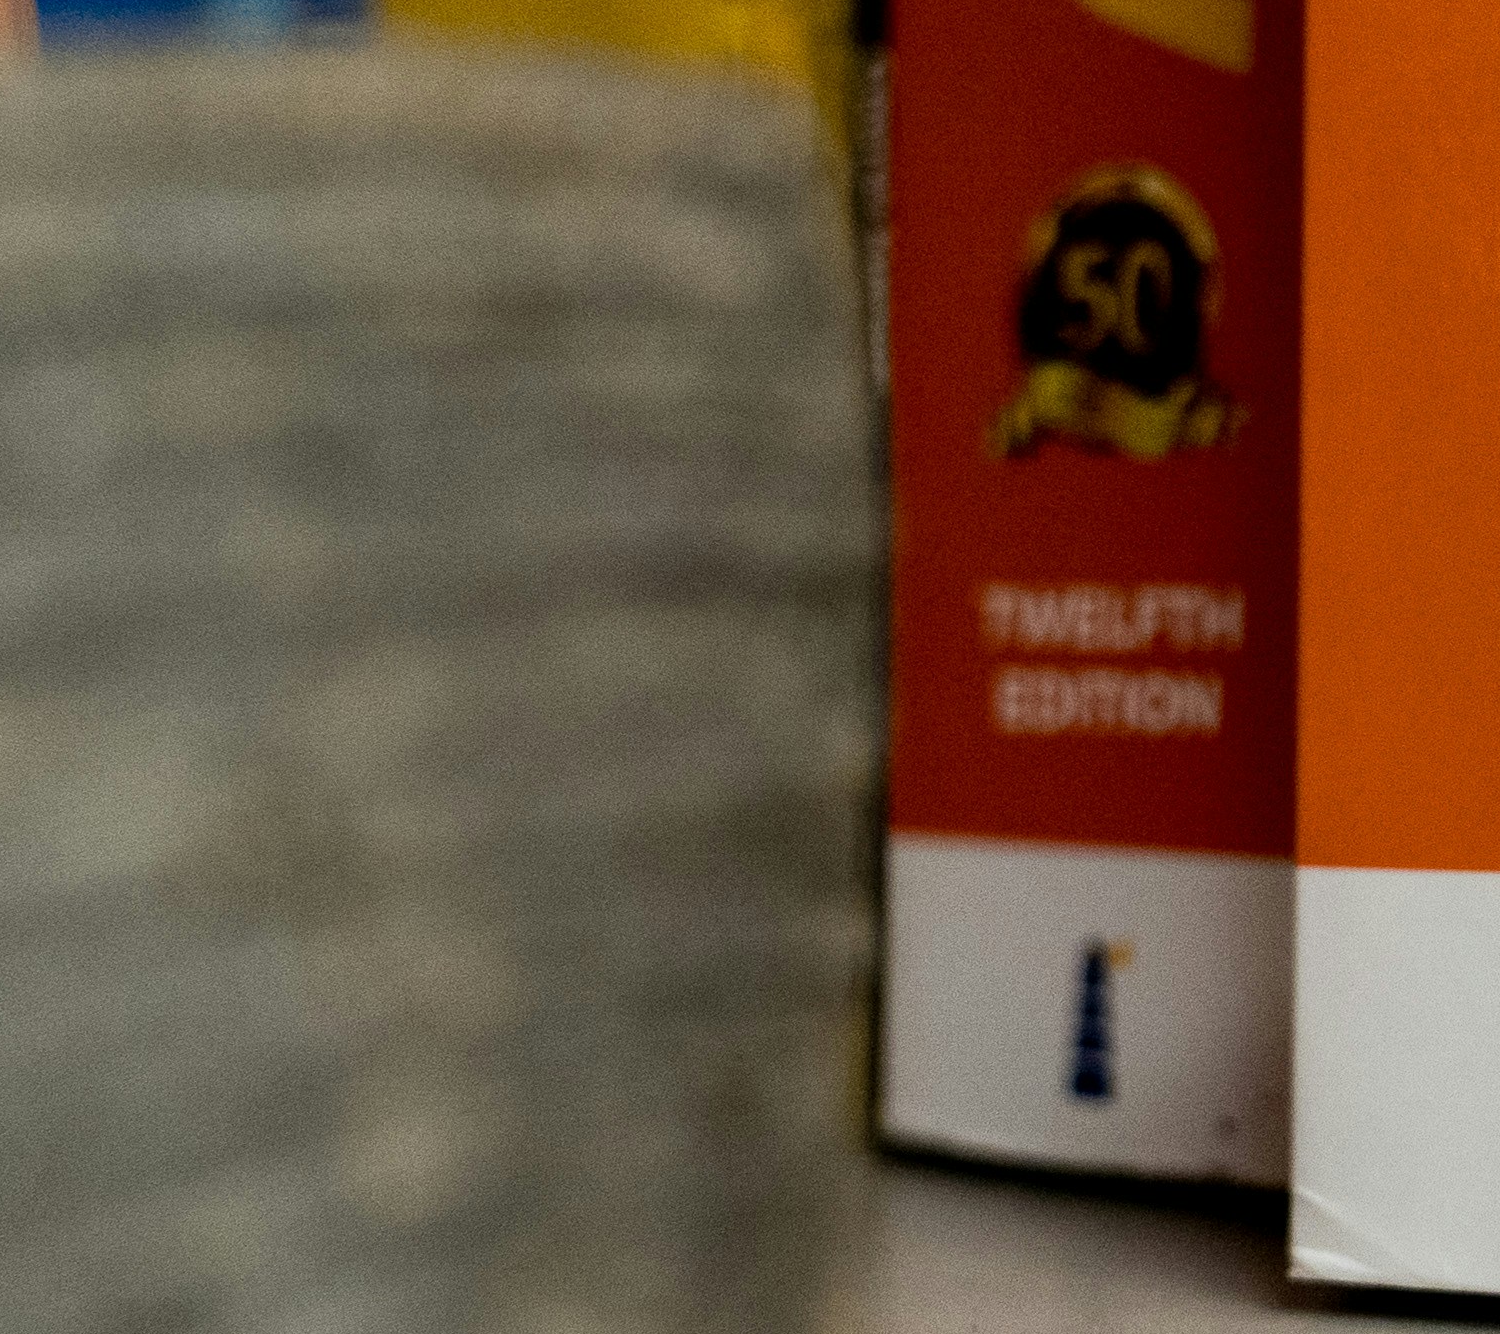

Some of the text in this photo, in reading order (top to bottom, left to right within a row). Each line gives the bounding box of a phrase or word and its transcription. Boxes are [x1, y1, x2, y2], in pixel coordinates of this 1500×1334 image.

[1058, 239, 1172, 355] 50
[984, 586, 1244, 650] TWELFTH
[994, 669, 1222, 732] EDITION
